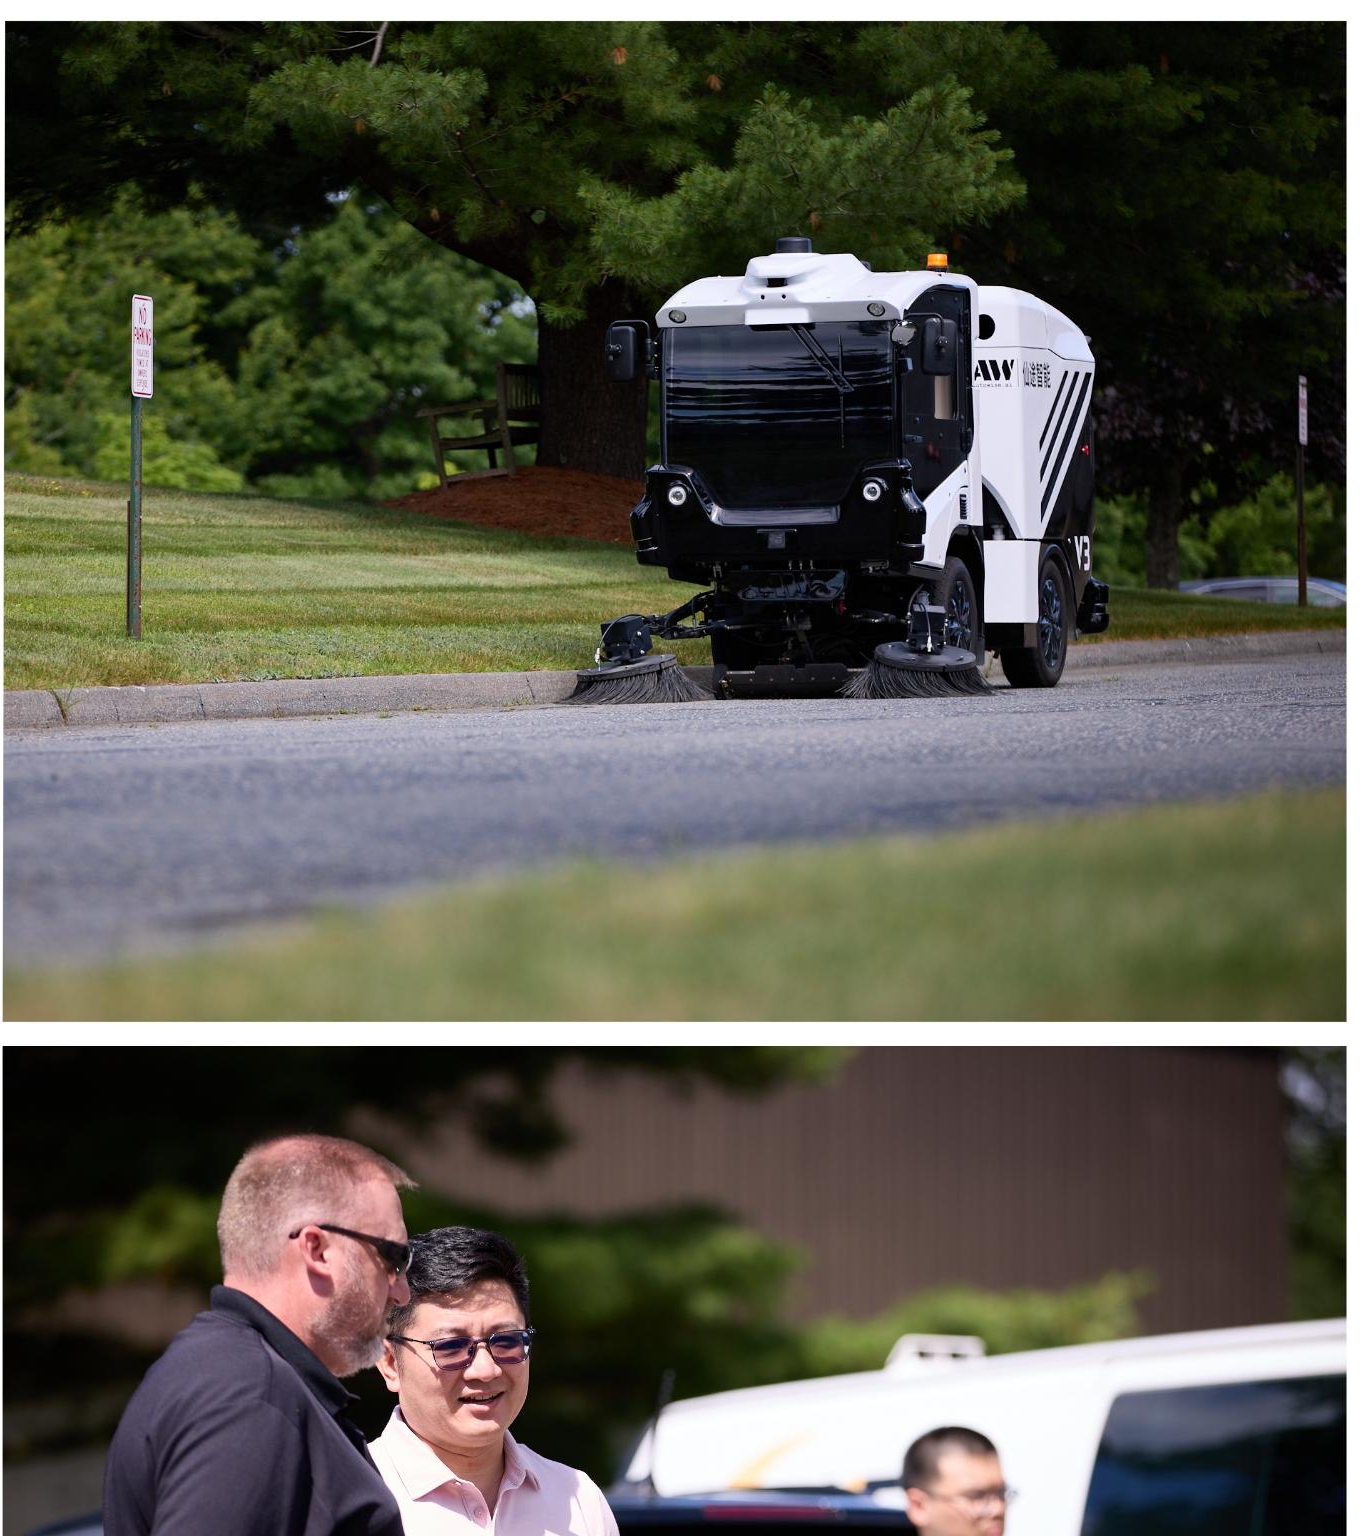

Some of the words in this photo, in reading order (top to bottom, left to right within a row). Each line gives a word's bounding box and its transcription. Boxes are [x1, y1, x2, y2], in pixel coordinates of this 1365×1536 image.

[138, 306, 147, 326] NO
[133, 326, 152, 346] PARKING
[1073, 535, 1091, 571] V3
